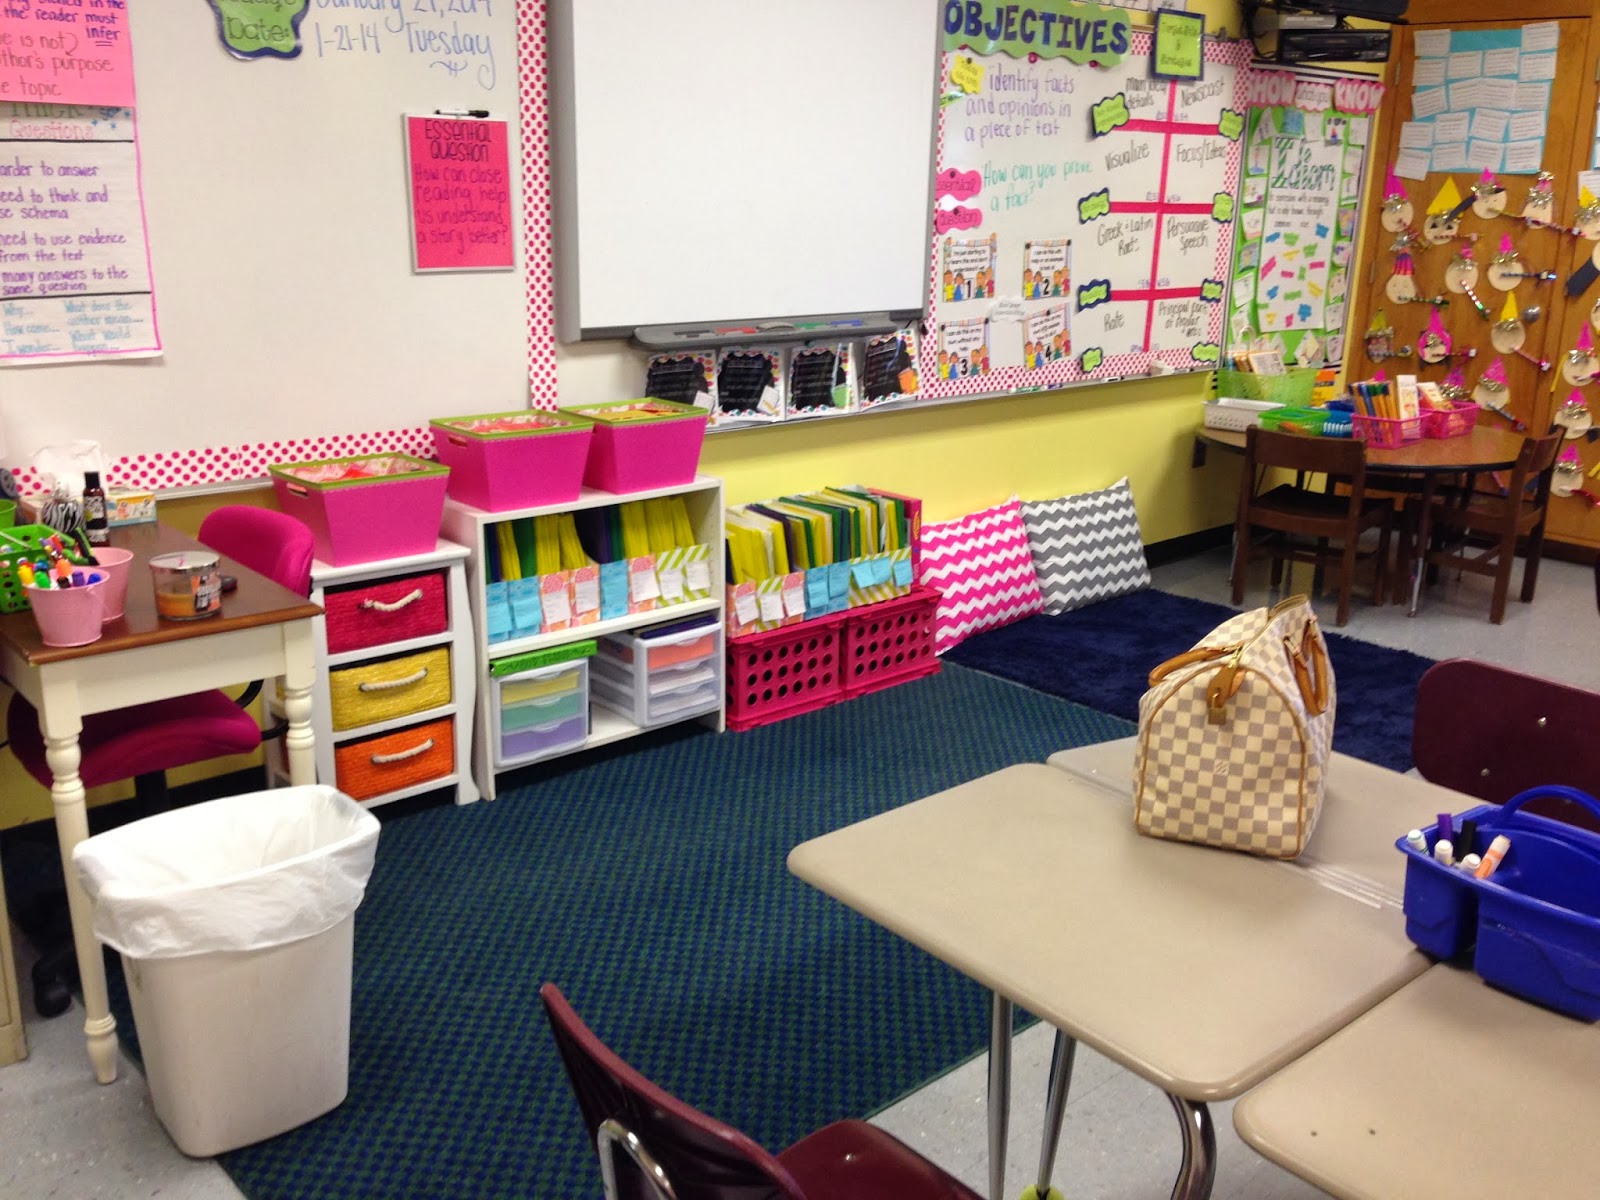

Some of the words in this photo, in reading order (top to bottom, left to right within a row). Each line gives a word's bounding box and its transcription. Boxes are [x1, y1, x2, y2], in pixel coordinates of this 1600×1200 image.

[35, 8, 78, 22] reader
[85, 13, 118, 24] must
[86, 27, 120, 41] infer
[944, 0, 1128, 54] OBJECTIVES
[314, 22, 382, 57] 1-21-14
[405, 21, 499, 90] Tuesday
[52, 58, 115, 78] purpose
[20, 75, 62, 100] topic
[989, 63, 1039, 105] identify
[1334, 79, 1386, 112] KNOW
[966, 96, 995, 116] and
[999, 100, 1055, 123] opinions
[1058, 104, 1072, 117] in
[980, 123, 1011, 149] piece
[1015, 118, 1030, 136] of
[41, 161, 55, 176] to
[58, 165, 99, 176] answer
[0, 186, 24, 203] eed
[30, 188, 44, 203] to
[86, 184, 109, 203] and
[936, 177, 979, 193] ssential
[415, 182, 473, 213] reading
[20, 205, 70, 220] schema
[34, 233, 47, 246] to
[51, 233, 74, 246] use
[35, 250, 57, 262] the
[38, 270, 88, 282] answers
[93, 268, 105, 280] to
[107, 265, 129, 280] the
[1043, 278, 1051, 296] 2
[1045, 345, 1052, 361] 4
[961, 358, 968, 376] 3
